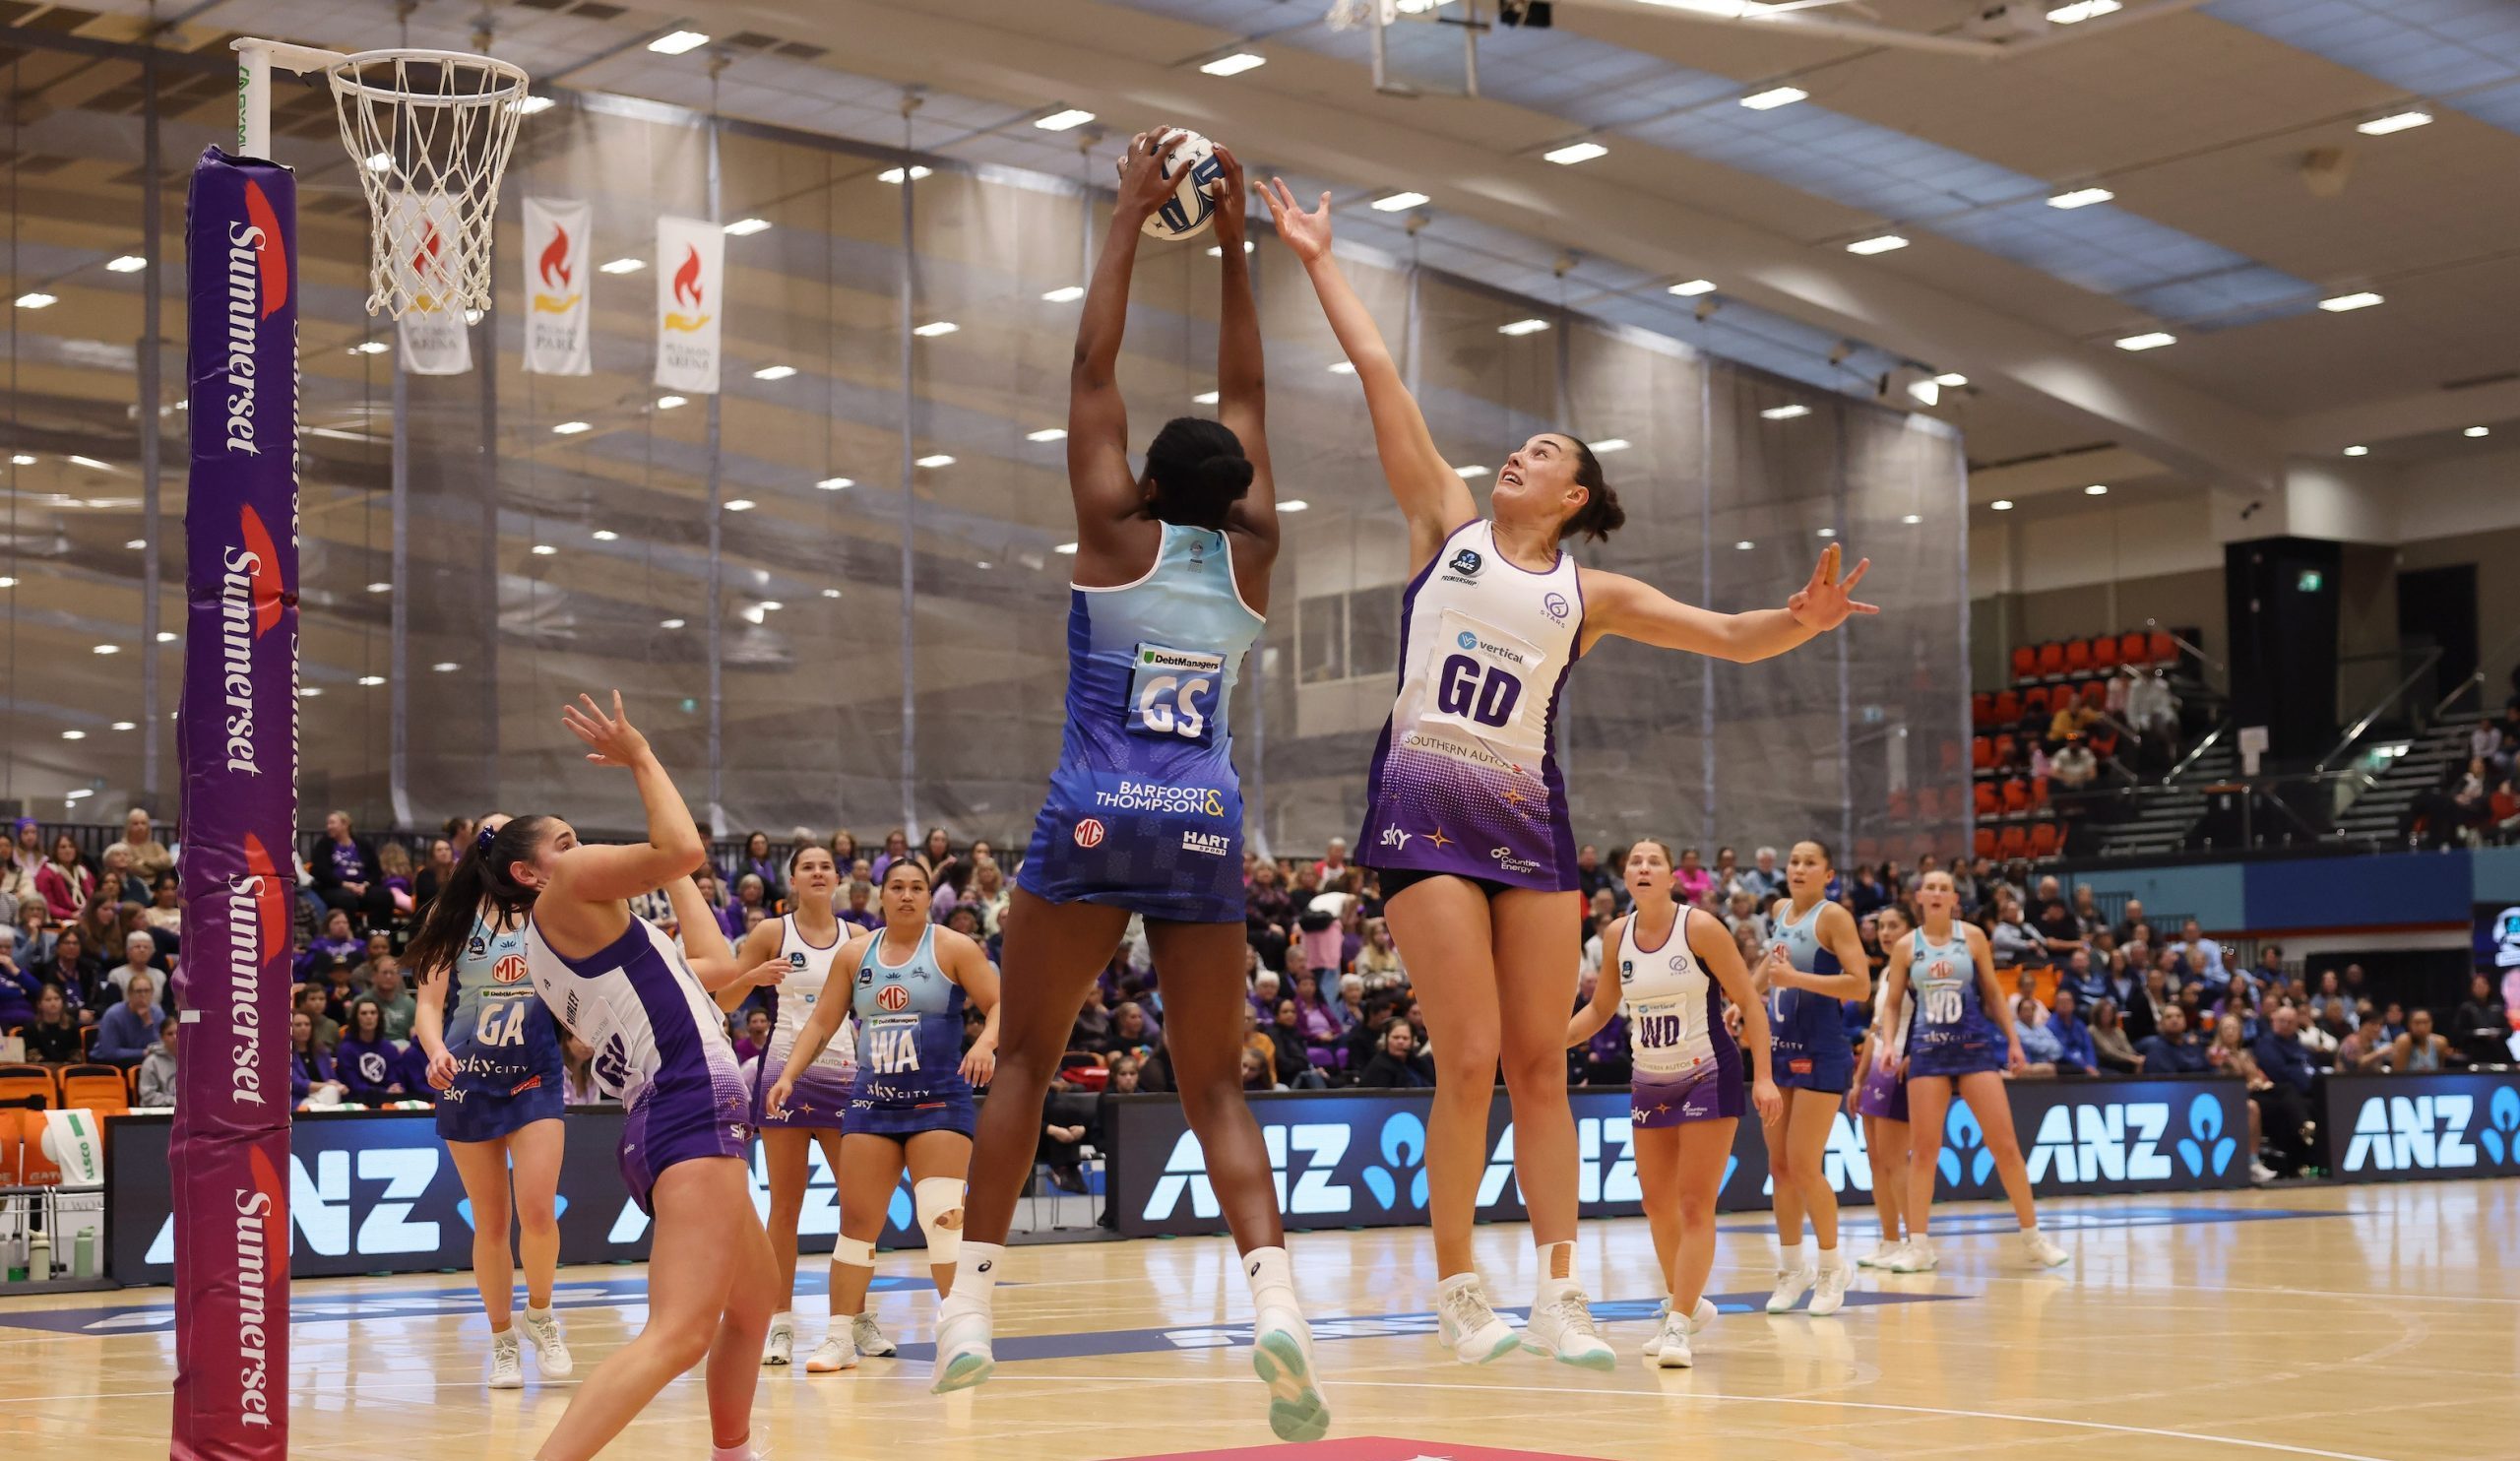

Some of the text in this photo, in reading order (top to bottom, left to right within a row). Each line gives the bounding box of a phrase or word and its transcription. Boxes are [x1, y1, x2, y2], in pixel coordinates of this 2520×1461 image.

[225, 221, 267, 458] Summerset
[1540, 608, 1566, 629] STARS
[221, 544, 263, 778] Summerset
[1155, 655, 1220, 669] DebtManagers
[1480, 639, 1525, 666] vertical
[1138, 675, 1210, 738] GS
[1437, 654, 1522, 728] GD
[1405, 733, 1468, 758] SOUTHERN
[1096, 791, 1204, 814] THOMPSON
[1118, 781, 1225, 818] BARFOOT &
[1076, 820, 1102, 846] MG
[1183, 830, 1230, 850] HART
[1199, 846, 1226, 856] SPORT
[1501, 856, 1542, 868] Counties
[1501, 862, 1534, 874] Energy
[494, 956, 527, 982] MG
[228, 873, 267, 1108] Summerset
[879, 986, 908, 1010] MG
[1774, 986, 1788, 1023] C
[1924, 989, 1963, 1024] WD
[476, 1001, 526, 1048] GA
[1640, 1014, 1680, 1048] WD
[869, 1029, 920, 1074] WA
[2026, 1102, 2173, 1184] ANZ
[2343, 1094, 2478, 1172] ANZ
[235, 1188, 273, 1430] Summerset
